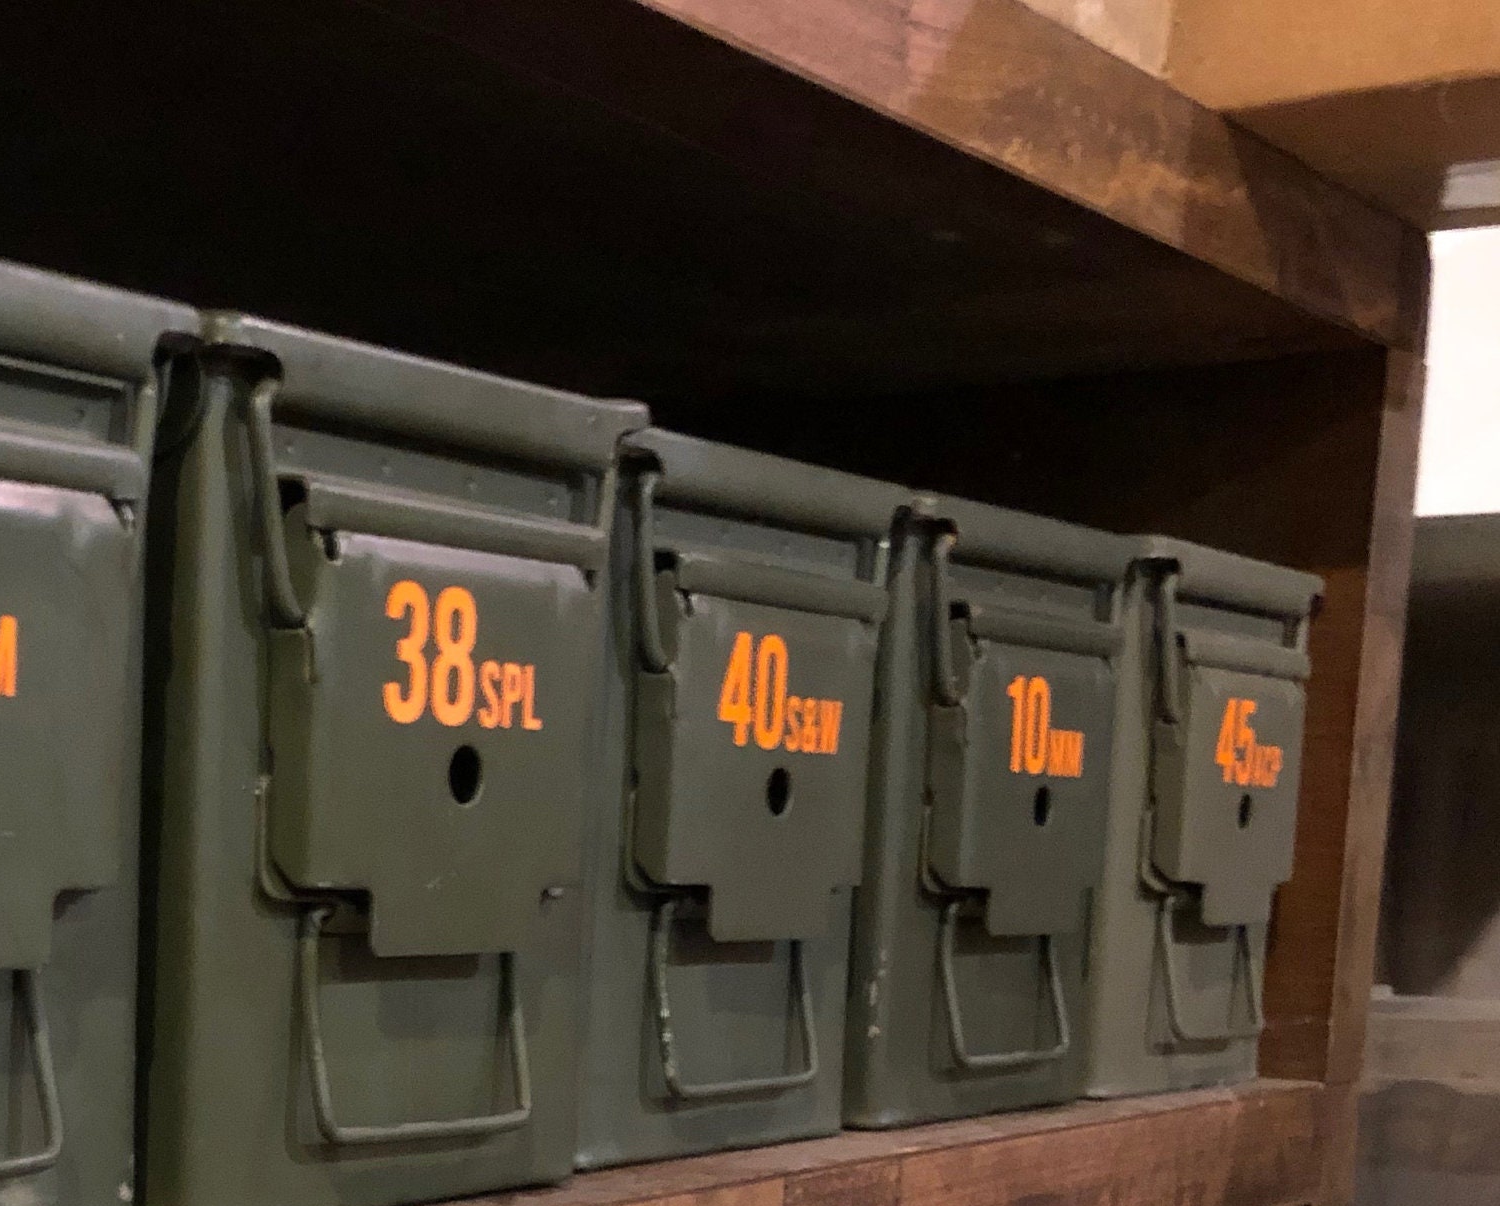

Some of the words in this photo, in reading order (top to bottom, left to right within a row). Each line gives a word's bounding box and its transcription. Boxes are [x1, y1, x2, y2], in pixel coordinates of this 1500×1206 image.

[383, 579, 477, 727] 38
[479, 660, 544, 730] SPL
[717, 631, 788, 752] 40
[1215, 698, 1257, 786] 45
